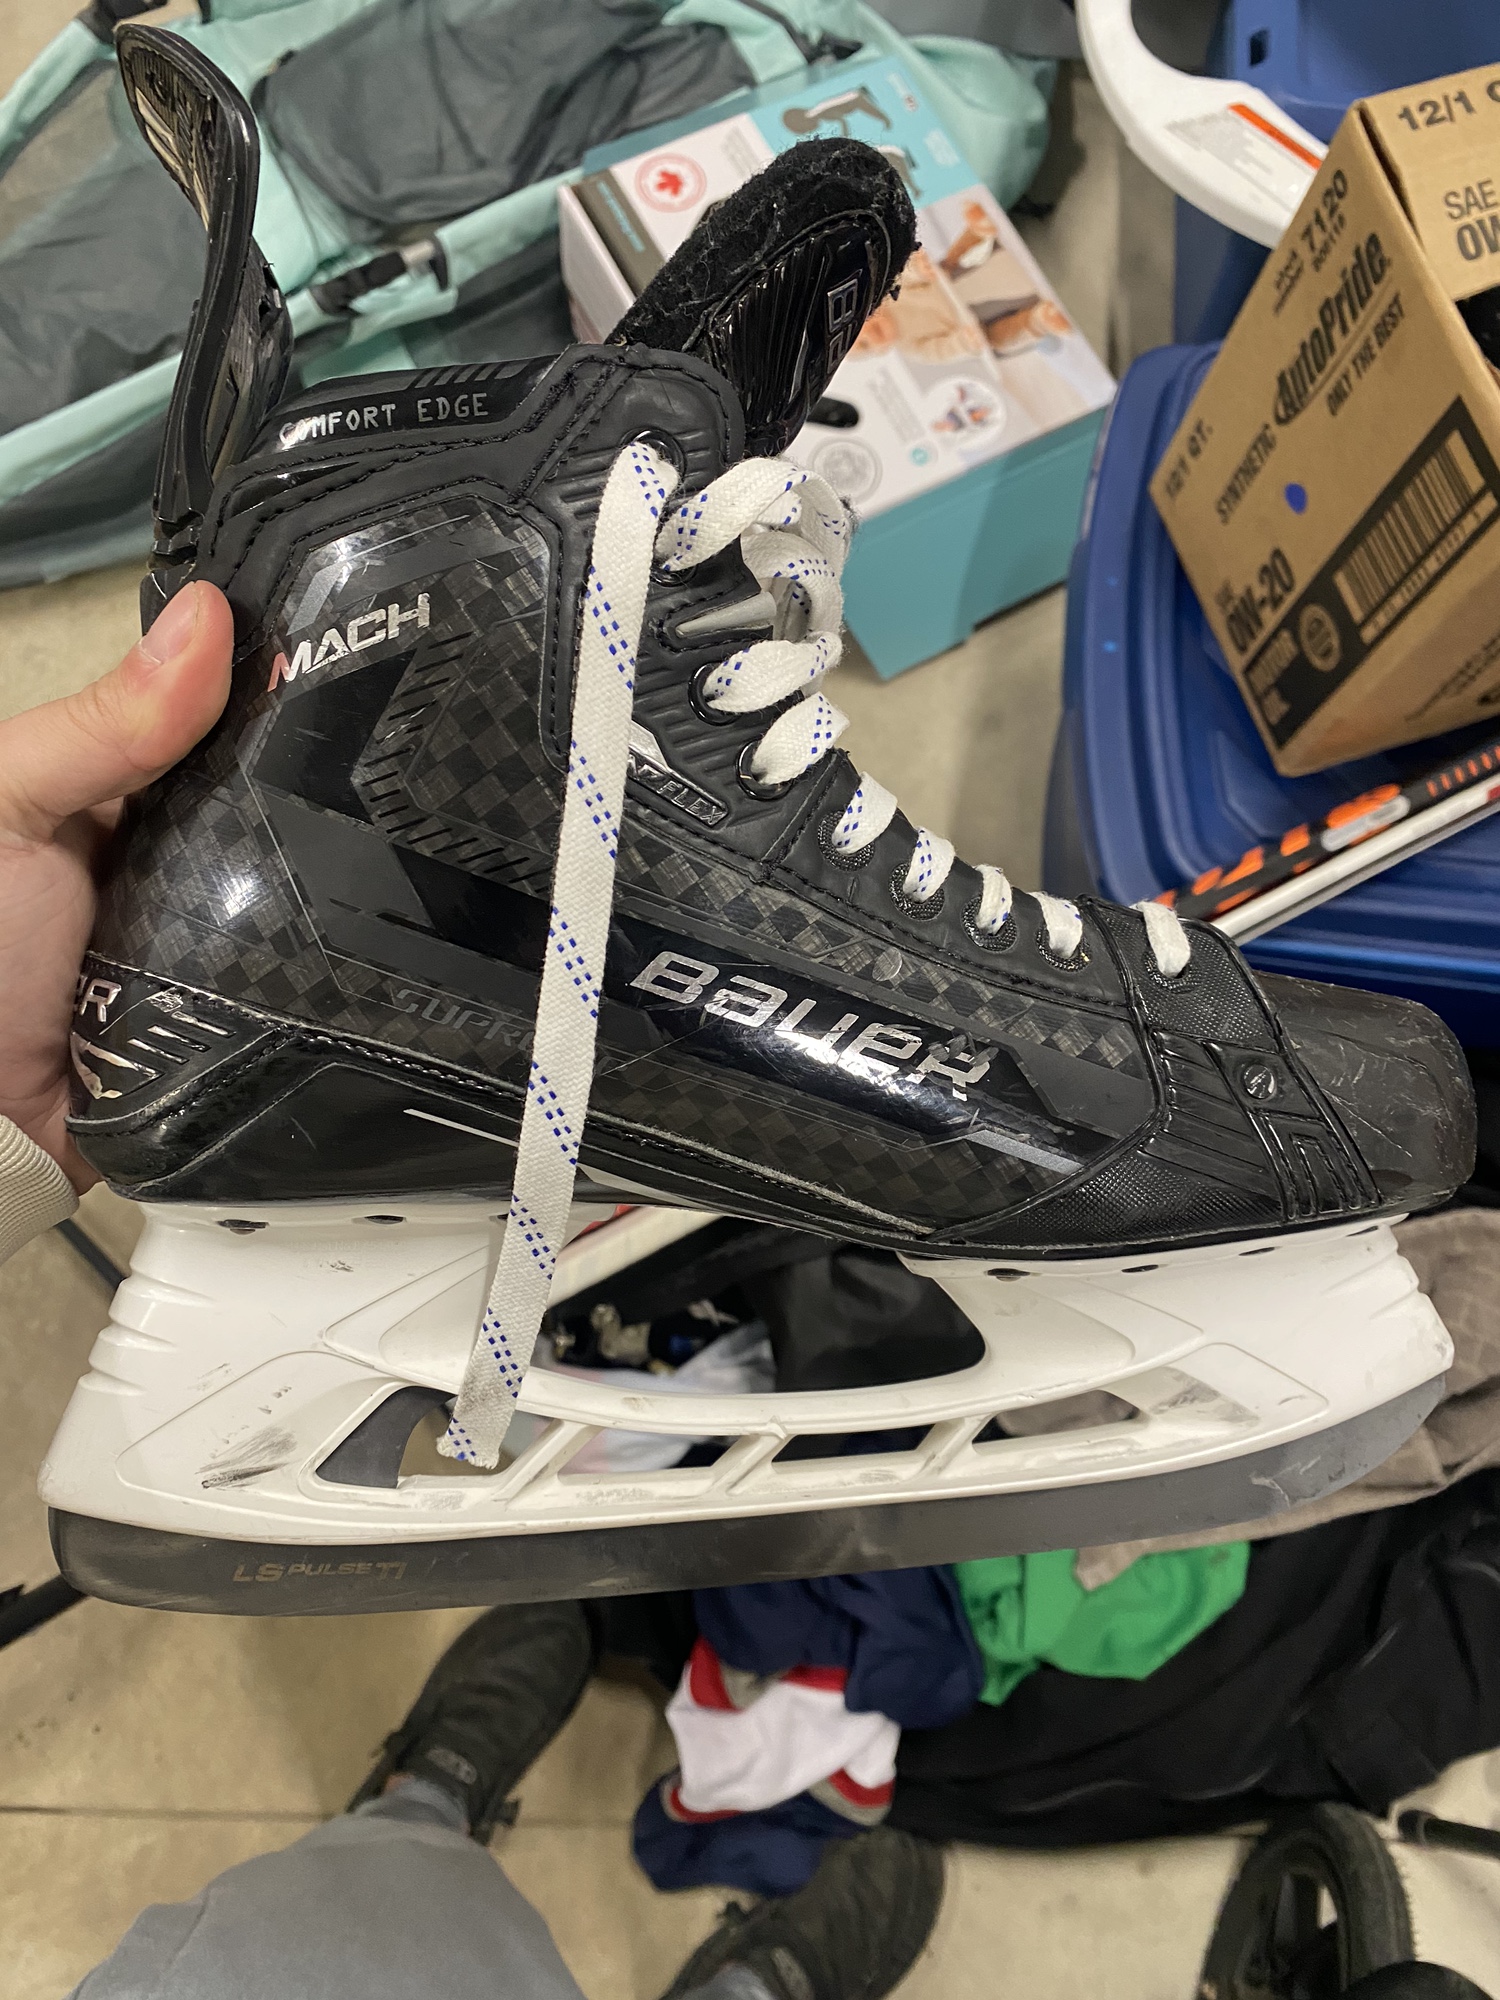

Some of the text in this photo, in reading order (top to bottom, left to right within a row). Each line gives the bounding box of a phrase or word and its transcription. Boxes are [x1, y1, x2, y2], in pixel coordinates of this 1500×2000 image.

[1399, 90, 1475, 131] 12/1
[1301, 169, 1348, 250] 7120
[1444, 179, 1499, 220] SAE
[1273, 233, 1391, 426] AutoPride
[1350, 336, 1378, 380] THE
[1376, 293, 1407, 352] BEST
[279, 392, 489, 449] COMFORT EDGE
[267, 592, 431, 692] MACH
[656, 780, 726, 825] FLEX
[232, 1563, 285, 1582] LS
[286, 1562, 373, 1577] PULSE
